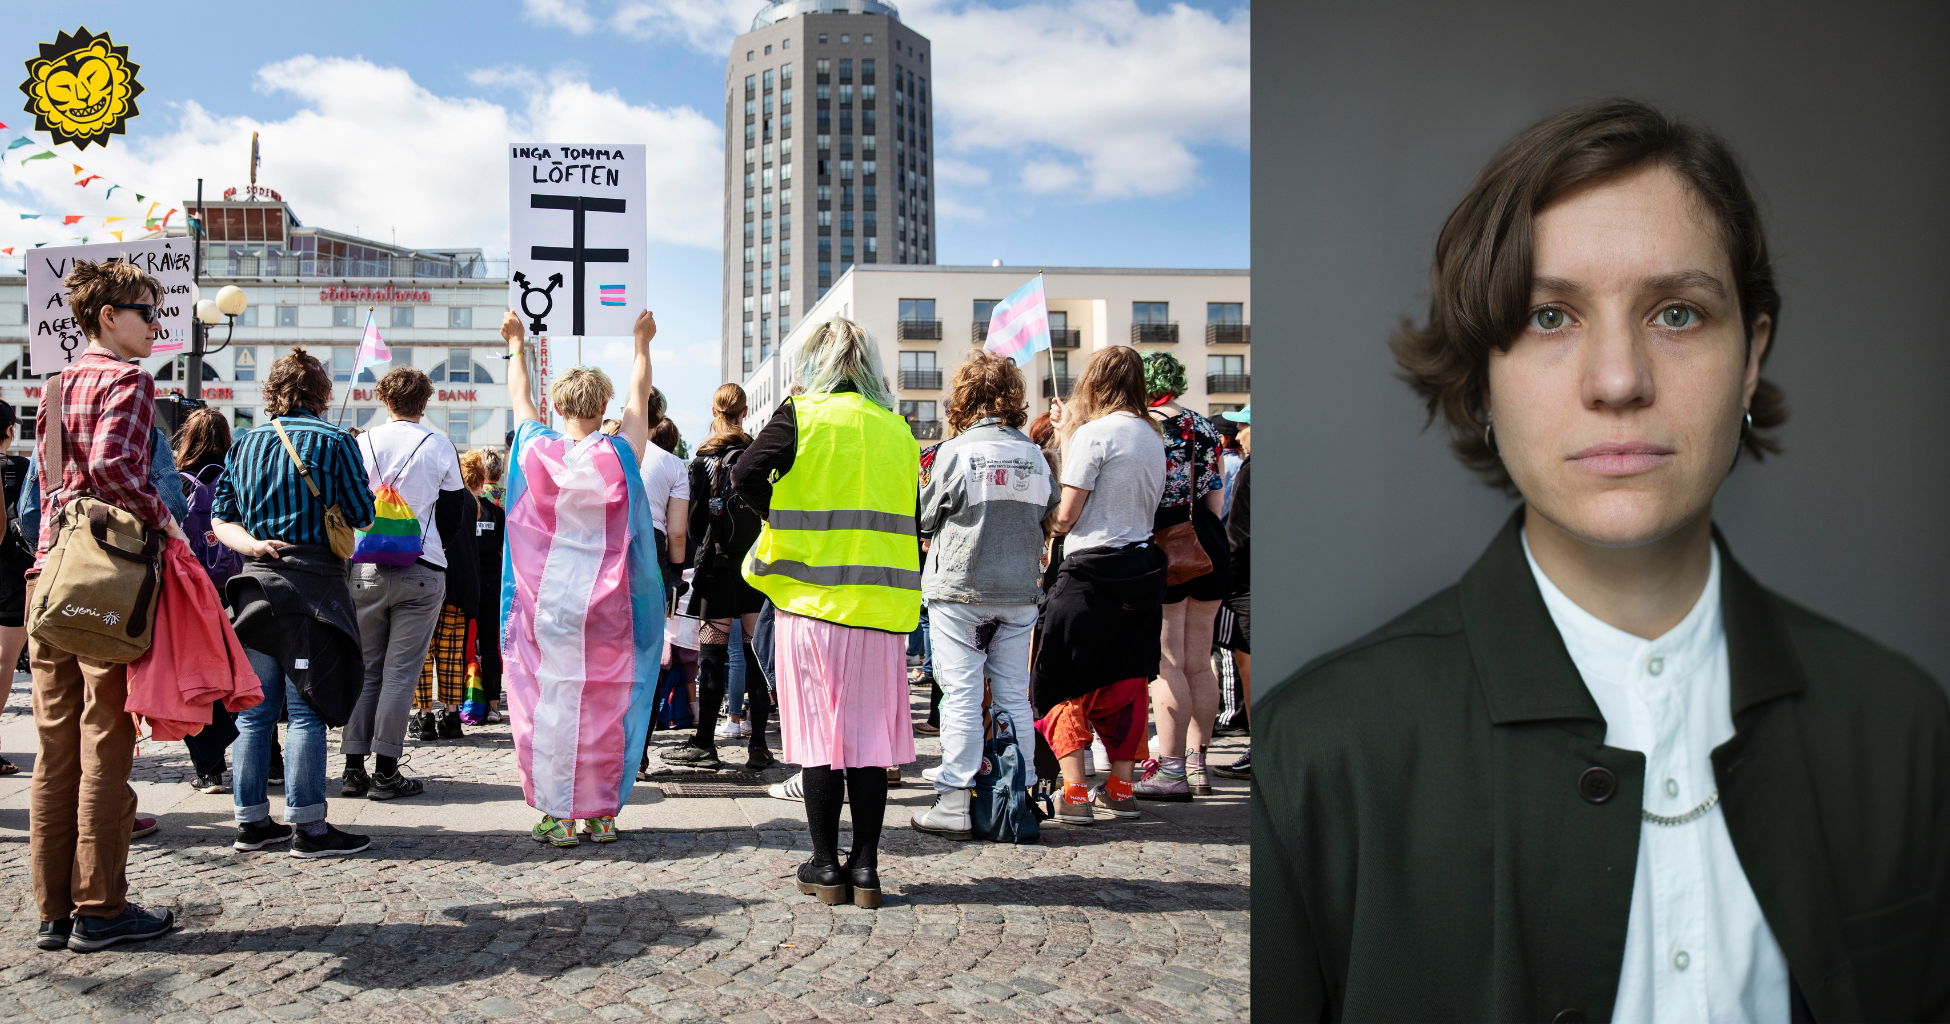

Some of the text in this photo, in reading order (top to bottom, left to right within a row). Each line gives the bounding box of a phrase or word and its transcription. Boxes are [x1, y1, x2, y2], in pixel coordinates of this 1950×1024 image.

[512, 147, 624, 161] INGA TOMMA
[438, 389, 478, 402] BANK
